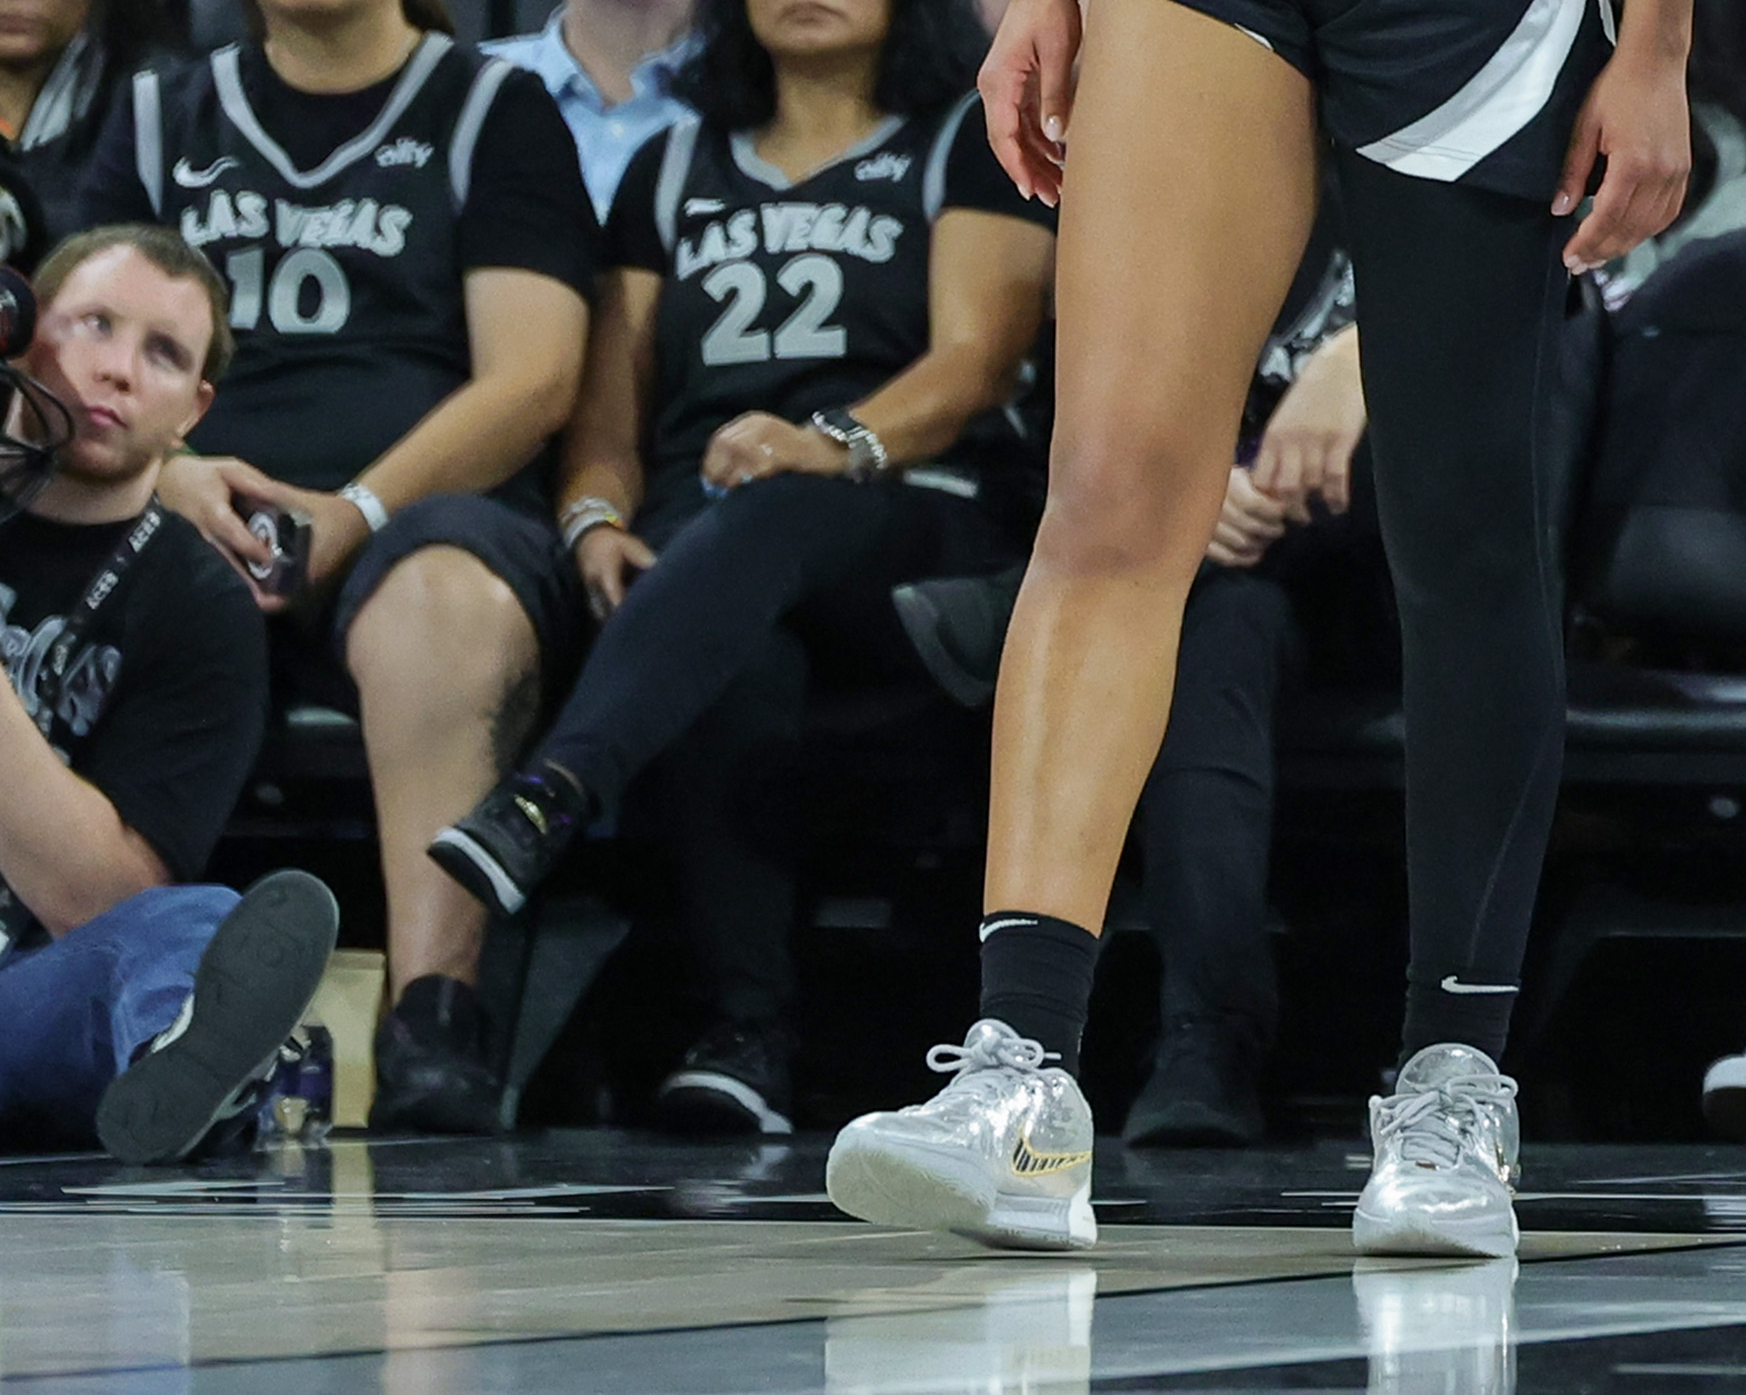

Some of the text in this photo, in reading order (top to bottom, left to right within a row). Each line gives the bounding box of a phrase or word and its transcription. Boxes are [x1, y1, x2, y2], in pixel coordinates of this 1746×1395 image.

[180, 189, 413, 258] LAS VEGAS
[676, 201, 904, 282] LAS VEGAS
[226, 245, 351, 334] 10
[701, 252, 848, 367] 22
